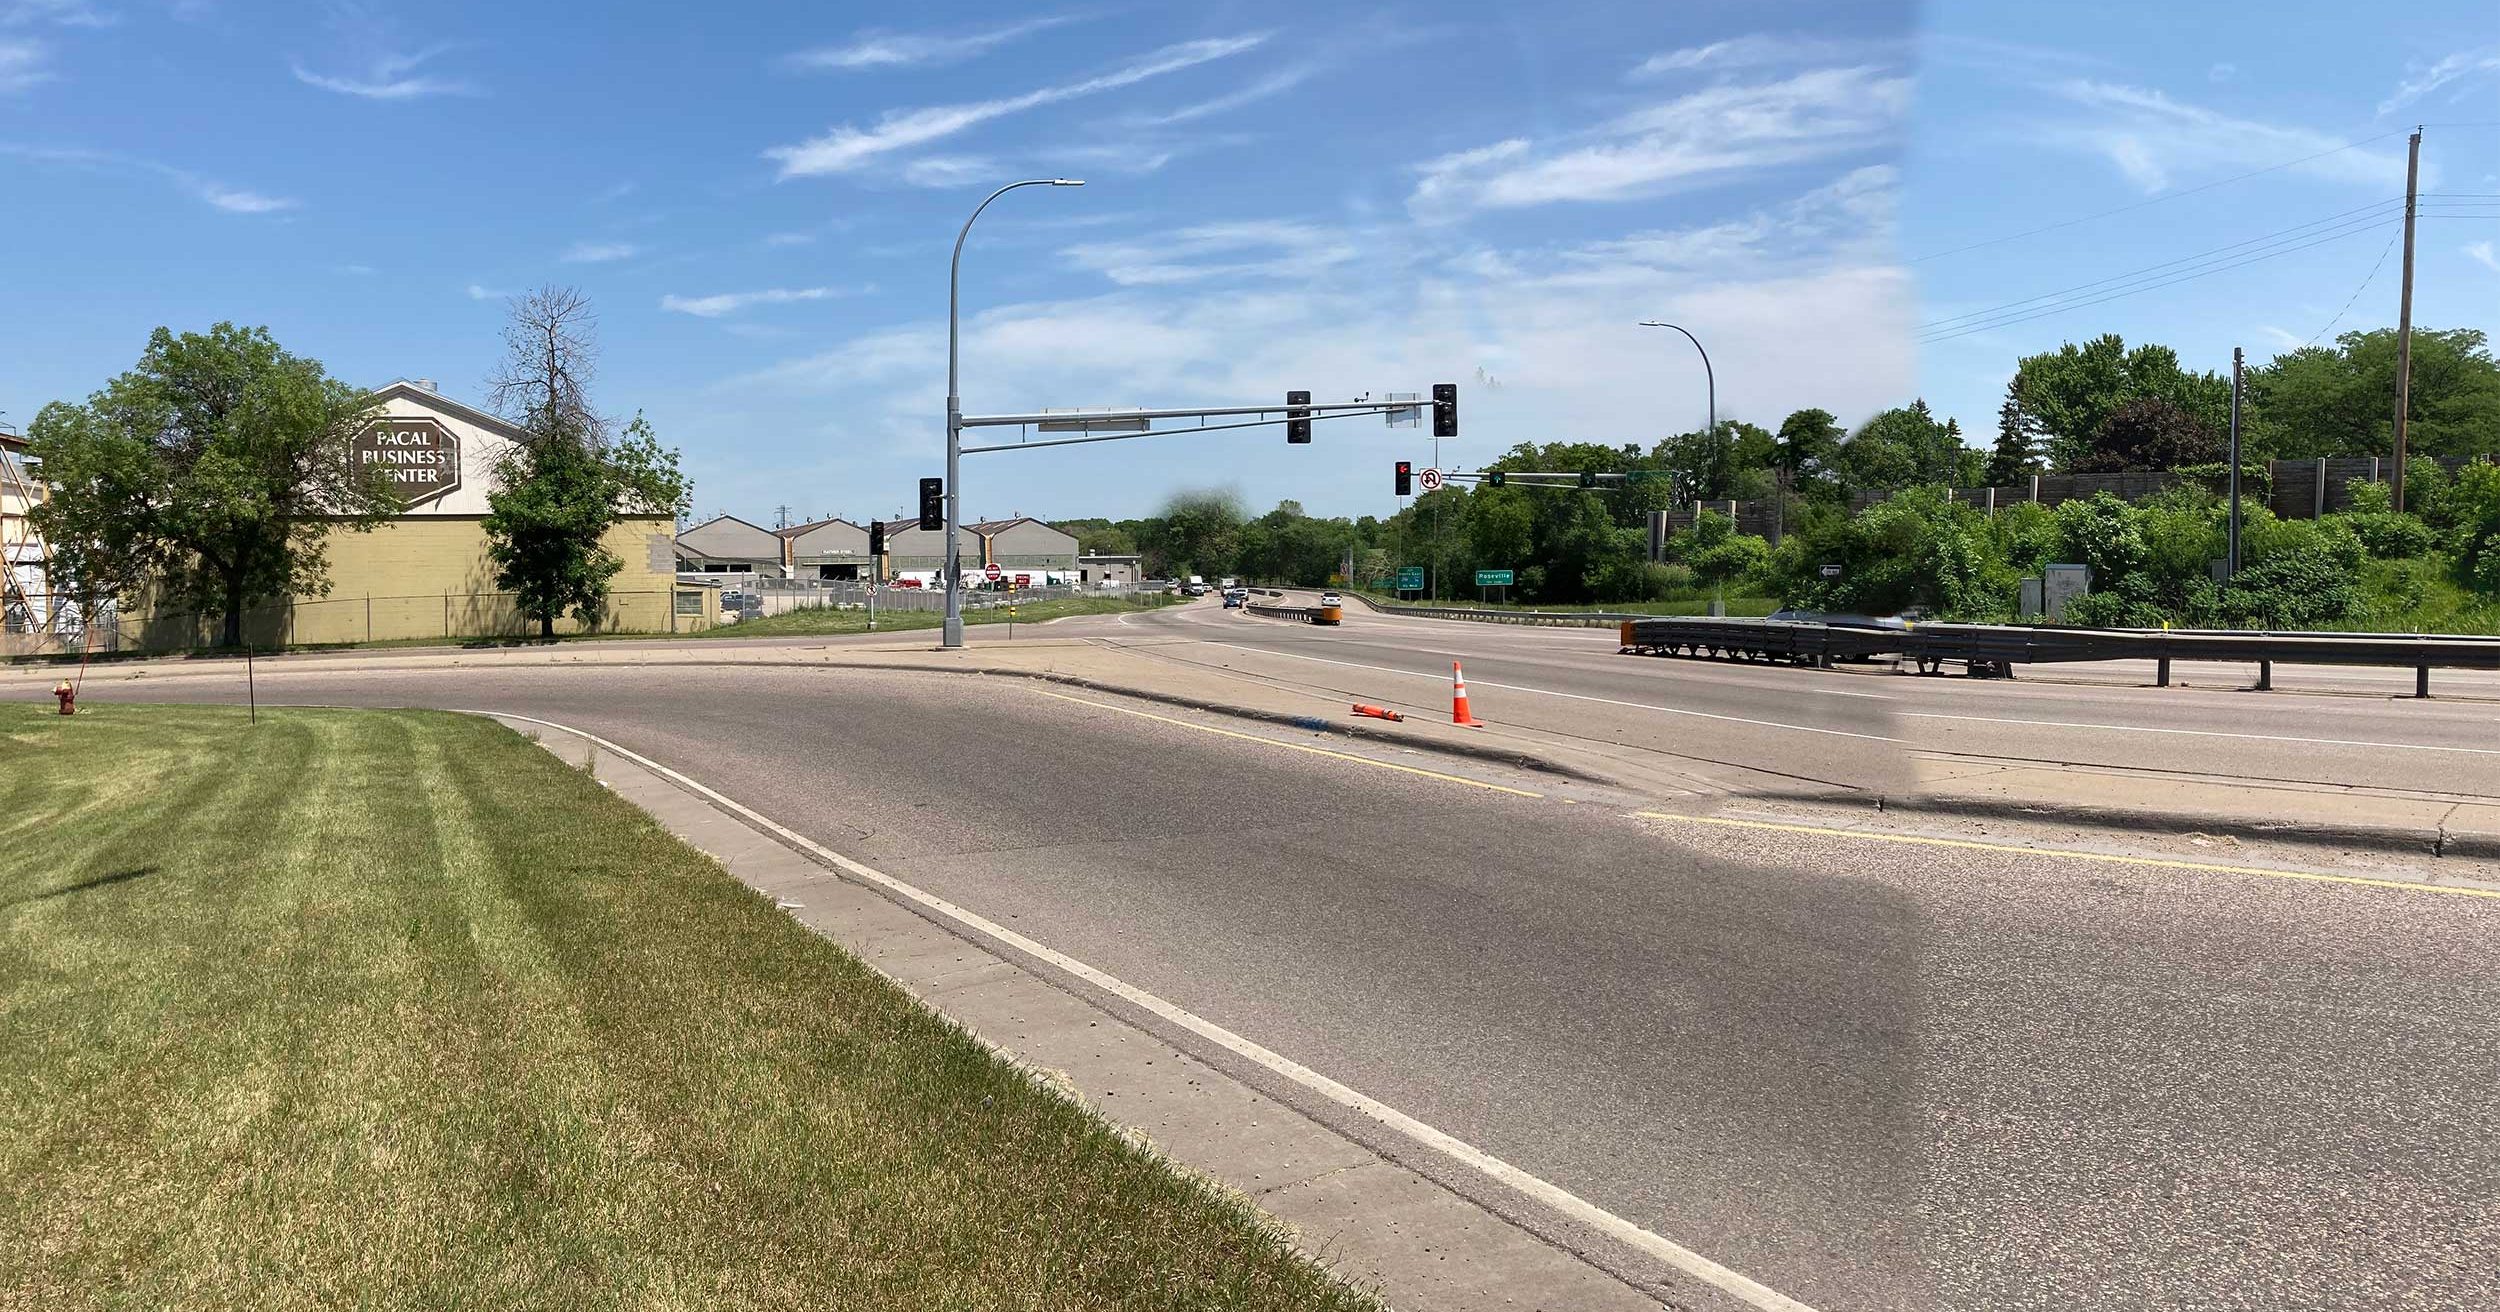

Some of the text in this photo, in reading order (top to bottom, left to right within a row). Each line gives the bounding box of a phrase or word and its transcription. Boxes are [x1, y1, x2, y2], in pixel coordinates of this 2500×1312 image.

[376, 431, 431, 446] PACAL
[362, 450, 446, 464] BUSINESS
[374, 468, 440, 482] ENTER
